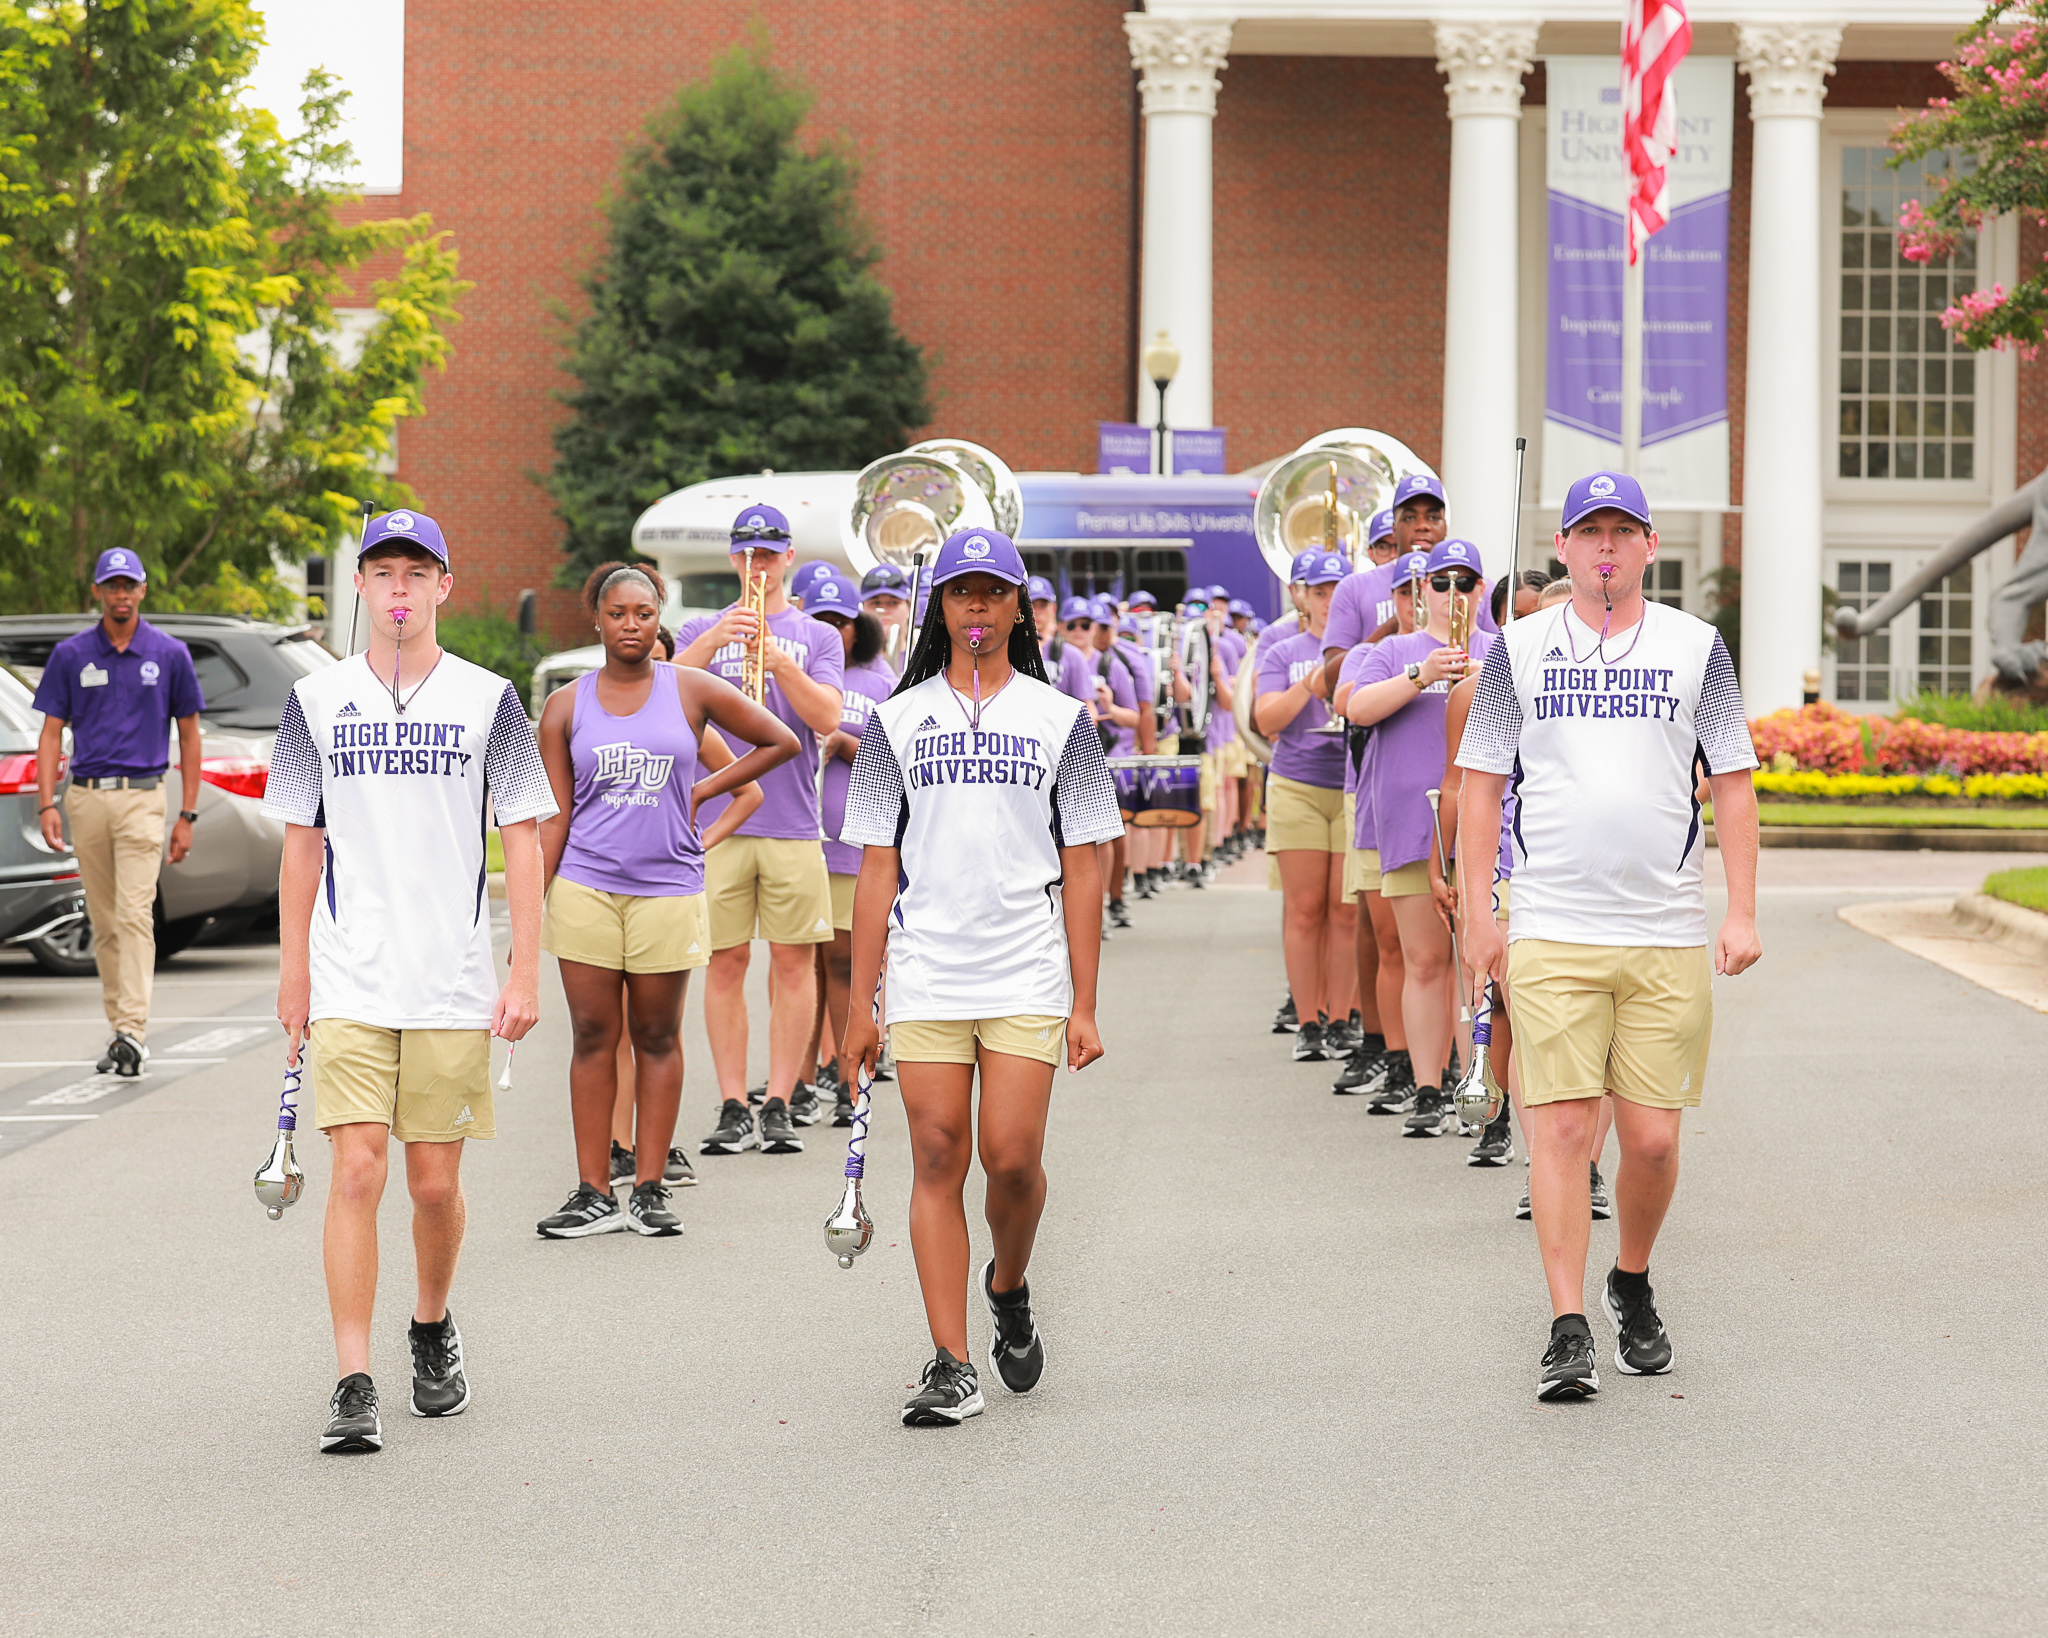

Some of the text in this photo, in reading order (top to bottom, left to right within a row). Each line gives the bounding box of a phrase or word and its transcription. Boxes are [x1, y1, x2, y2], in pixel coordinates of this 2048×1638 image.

[1650, 244, 1722, 262] Education
[1076, 511, 1254, 535] Premier Life Skills University
[1542, 654, 1568, 662] adidas
[1543, 668, 1673, 692] HIGH POINT
[1534, 693, 1680, 722] UNIVERSITY
[333, 722, 465, 749] HIGH POINT
[917, 723, 941, 732] adidas
[914, 731, 1041, 761] HIGH POINT
[328, 750, 471, 777] UNIVERSITY
[591, 741, 675, 791] HPU
[908, 758, 1047, 791] UNIVERSITY
[600, 792, 660, 810] majorettes
